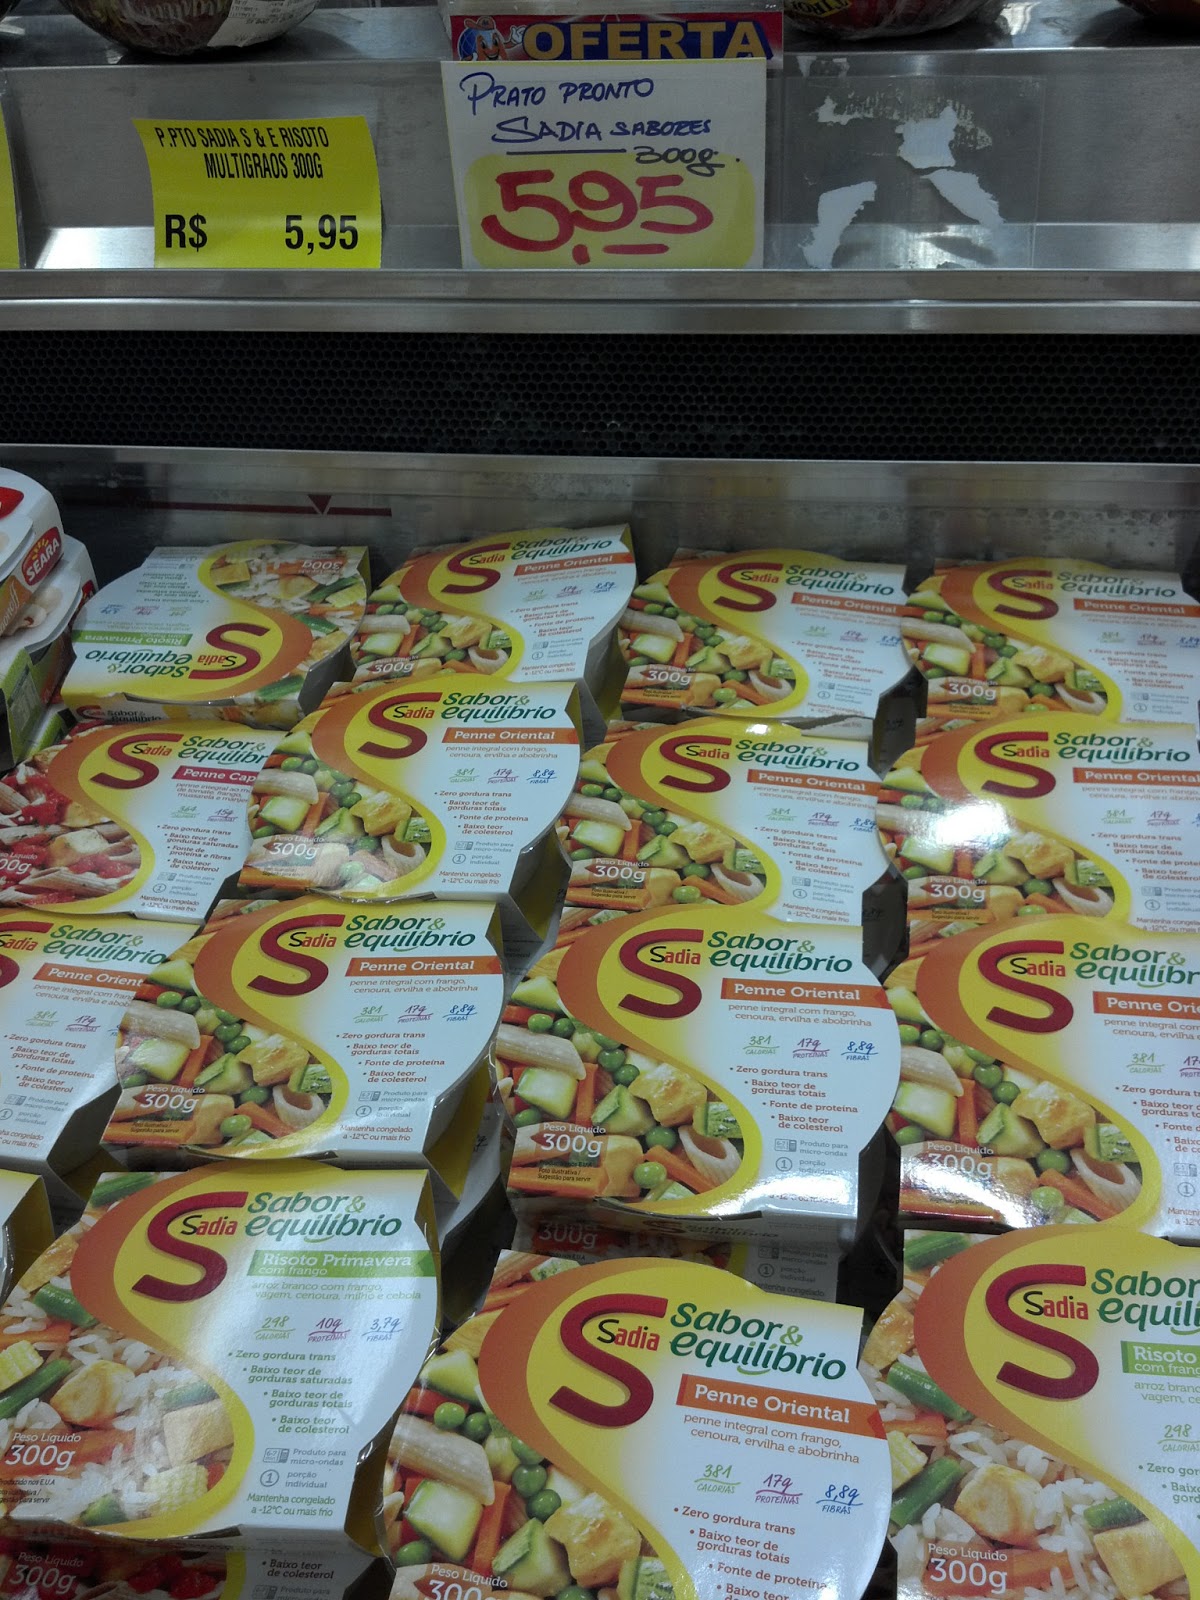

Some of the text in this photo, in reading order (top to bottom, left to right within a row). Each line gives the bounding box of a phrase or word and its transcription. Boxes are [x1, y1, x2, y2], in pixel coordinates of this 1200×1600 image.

[523, 21, 767, 59] OFERTA
[559, 78, 654, 103] PRONTO
[200, 127, 240, 147] SADIA
[243, 127, 252, 147] S
[256, 128, 265, 147] &
[268, 127, 278, 147] E
[280, 126, 329, 147] RISOTO
[491, 116, 602, 143] SADIA
[204, 152, 324, 179] MULTIGRAOS 300G
[165, 213, 358, 255] R$ 5,95
[26, 538, 60, 581] SEARA
[469, 554, 506, 566] Sadia
[524, 555, 613, 572] Penne Oriental
[740, 571, 779, 584] Sadia
[1012, 578, 1054, 590] Sadia
[802, 595, 897, 614] Penne Oriental
[1084, 601, 1185, 615] Penne Oriental
[197, 654, 238, 668] Sadia
[372, 662, 415, 674] 300g
[647, 669, 692, 686] 300g
[948, 683, 997, 701] 300g
[393, 705, 435, 719] Sadia
[454, 730, 555, 740] Penne Oriental
[131, 743, 172, 757] Sadia
[178, 748, 268, 765] equilíbr
[686, 745, 730, 760] Sadia
[1002, 744, 1049, 758] Sadia
[184, 769, 256, 782] Penne Cap
[758, 772, 866, 792] Penne Oriental
[1085, 771, 1133, 781] Penne
[269, 842, 318, 858] 300g
[593, 865, 647, 883] 300g
[930, 885, 985, 903] 300g
[289, 932, 337, 948] Sadia
[649, 946, 701, 964] Sadia
[359, 960, 475, 972] Penne Oriental
[1010, 957, 1066, 977] Sadia
[48, 968, 143, 987] Penne Orient
[734, 983, 860, 1000] Penne Oriental
[1106, 997, 1162, 1010] Penne
[761, 1068, 800, 1076] gordura
[139, 1092, 198, 1113] 300g
[543, 1123, 567, 1133] Peso
[540, 1133, 603, 1158] 300g
[181, 1214, 237, 1236] Sadia
[262, 1253, 412, 1267] Risoto Primavera
[258, 1266, 328, 1278] com frango
[1023, 1291, 1089, 1320] Sadia
[596, 1318, 659, 1351] Sadia
[1132, 1346, 1197, 1364] Risoto
[1134, 1363, 1165, 1372] com
[695, 1384, 850, 1423] Penne Oriental
[13, 1433, 38, 1442] Peso
[684, 1413, 842, 1448] penne integral com frango,
[691, 1428, 860, 1464] cenoura, ervilha e abobrinha
[5, 1445, 76, 1471] 300g
[703, 1465, 732, 1479] 381
[696, 1484, 735, 1494] CALORIAS
[284, 1507, 333, 1516] ou mais frio
[822, 1504, 851, 1515] FIBRAS
[682, 1506, 796, 1535] Zero gordura trans
[699, 1528, 779, 1551] Baixo teor de
[697, 1540, 790, 1564] gorduras totais
[928, 1543, 957, 1556] Peso
[270, 1559, 322, 1570] Baixo teor
[431, 1564, 460, 1579] Peso
[717, 1562, 752, 1578] Fonte
[755, 1571, 771, 1580] de
[9, 1565, 76, 1594] 300g
[267, 1569, 334, 1579] de colesterol
[929, 1558, 1008, 1594] 300g
